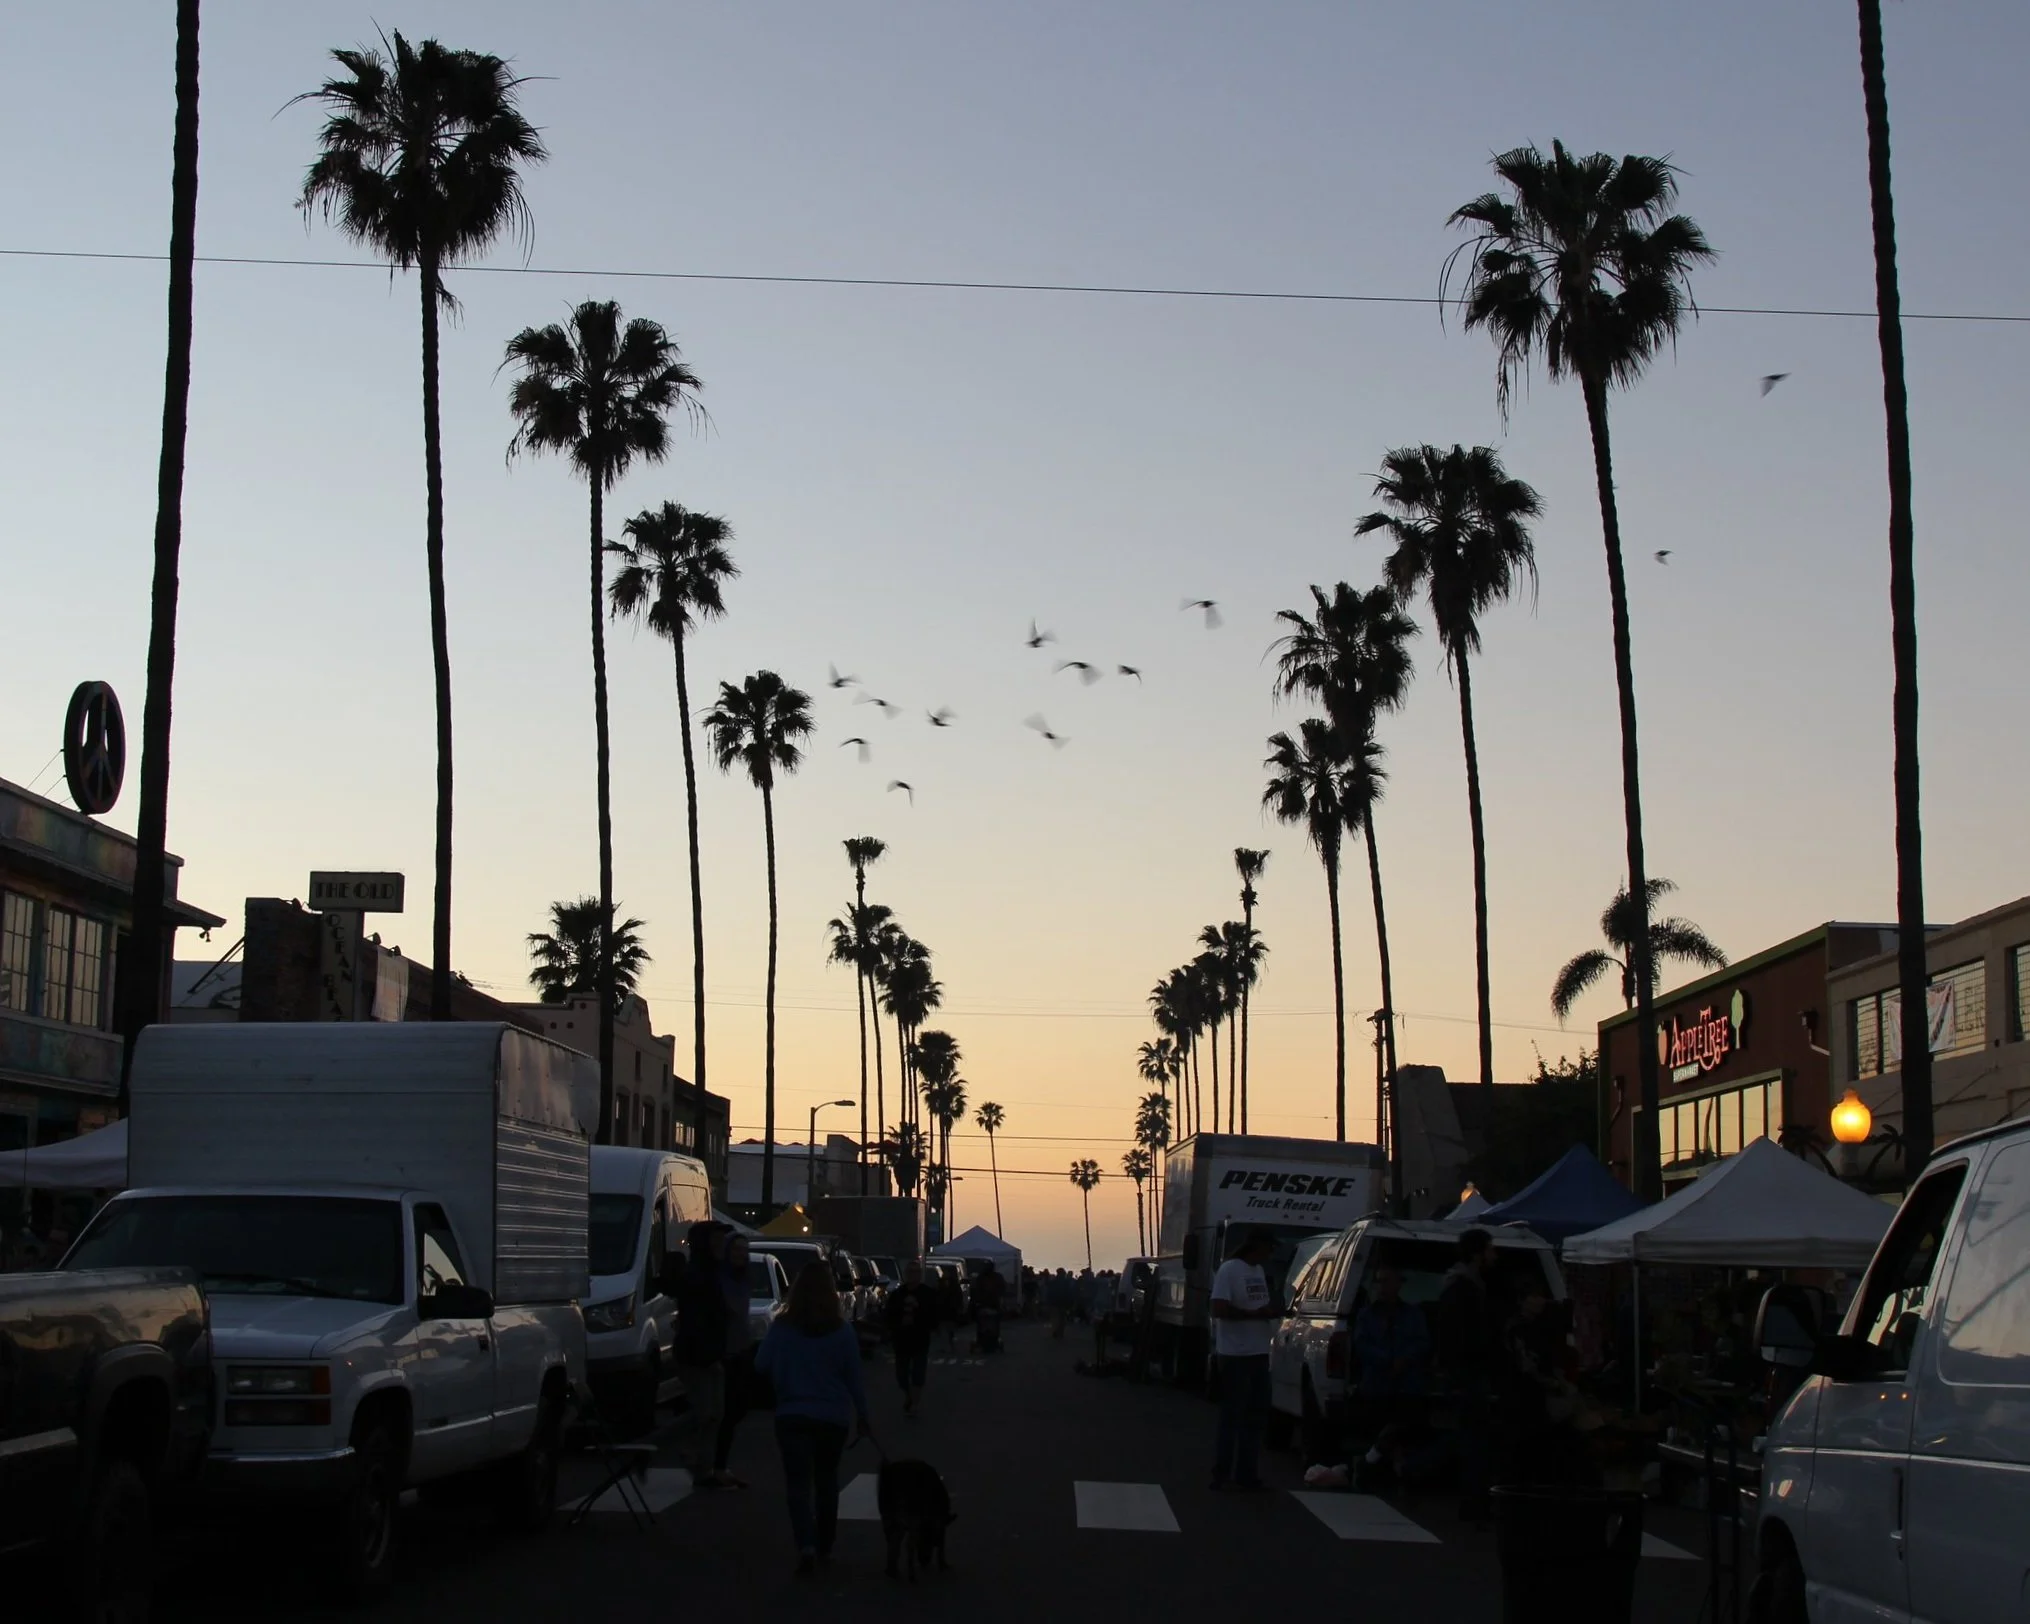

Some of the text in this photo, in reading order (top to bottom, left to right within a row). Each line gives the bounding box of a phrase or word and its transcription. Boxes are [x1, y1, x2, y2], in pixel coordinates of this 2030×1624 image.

[315, 881, 394, 899] THE OLD
[326, 914, 352, 983] OCEAN
[1219, 1170, 1355, 1197] PENSKE
[1246, 1196, 1325, 1212] Truck Rental
